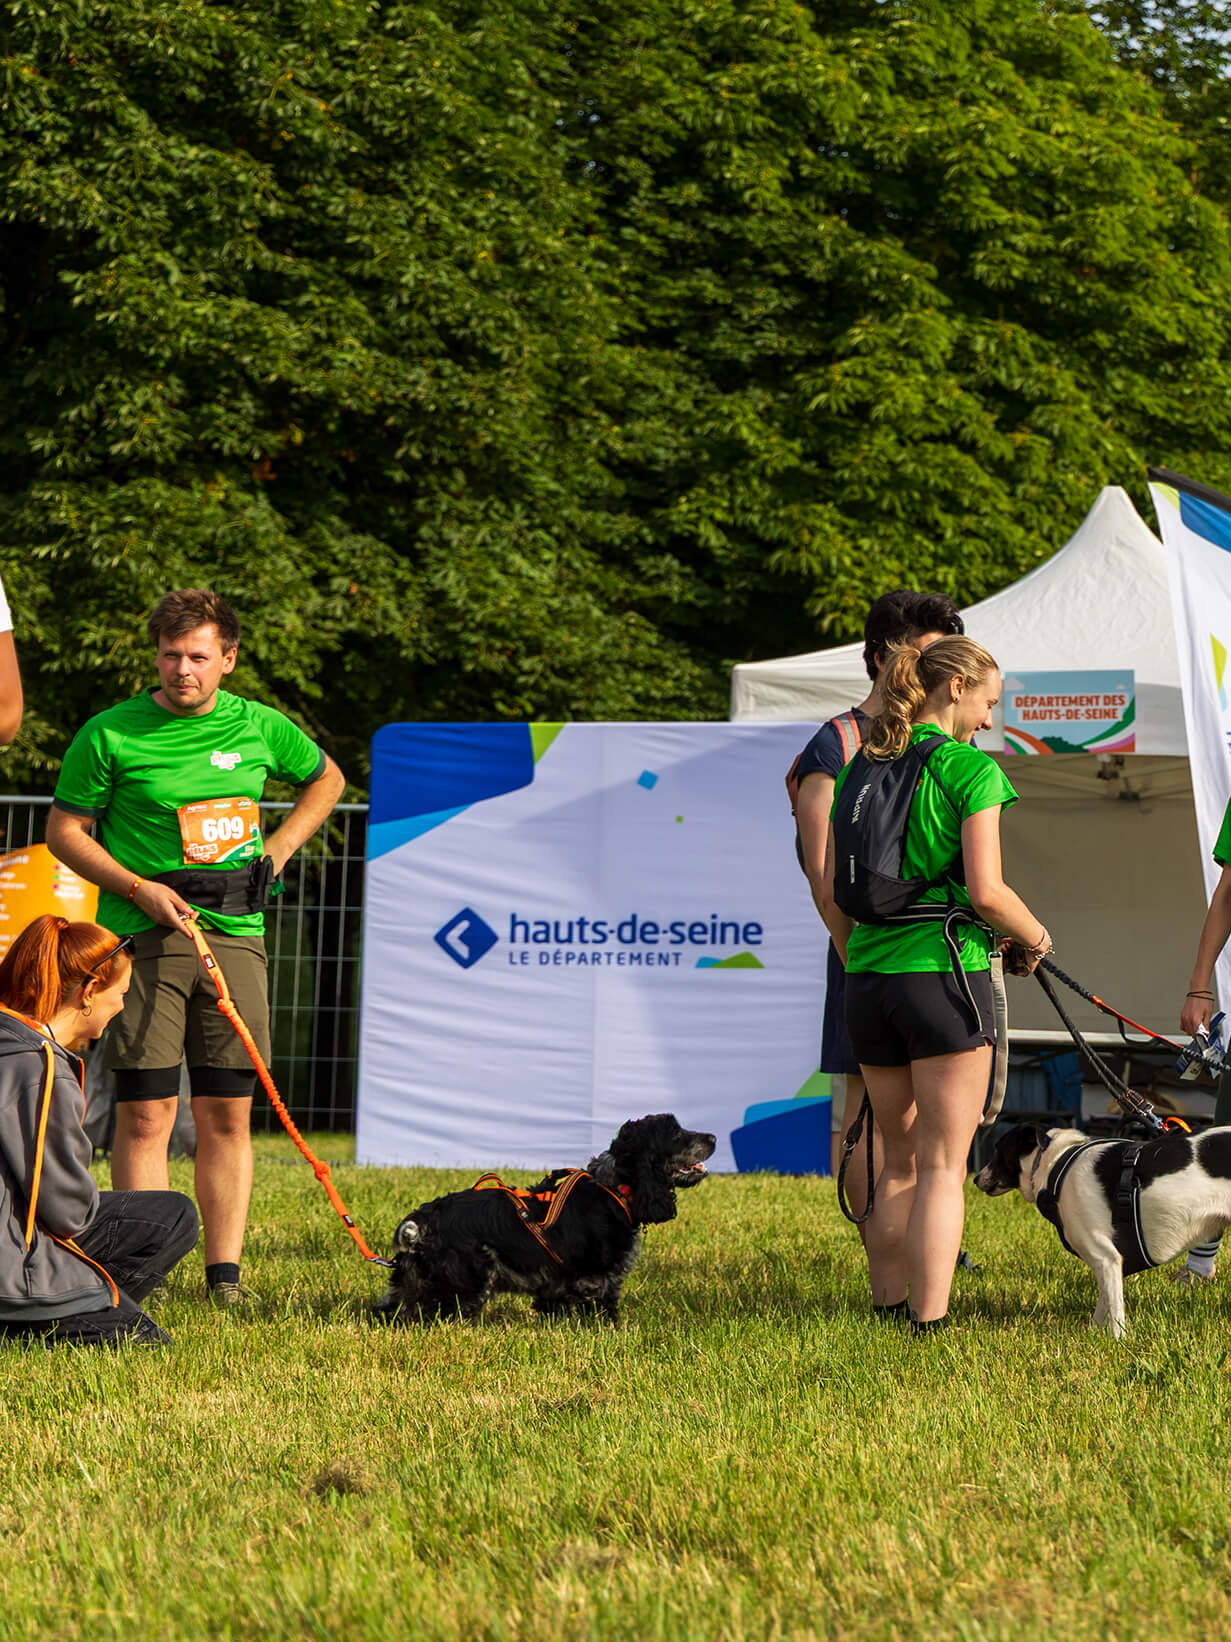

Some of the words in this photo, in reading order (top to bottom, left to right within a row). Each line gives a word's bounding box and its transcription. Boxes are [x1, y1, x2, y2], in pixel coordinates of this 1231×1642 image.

[1015, 694, 1100, 708] DÉPARTEMENT
[1103, 694, 1126, 706] DES
[1022, 708, 1119, 721] HAUTS-DE-SEINE
[202, 816, 244, 842] 609
[509, 913, 764, 945] hauts-de-seine
[508, 951, 530, 966] LE
[538, 948, 684, 966] DÉPARTEMENT
